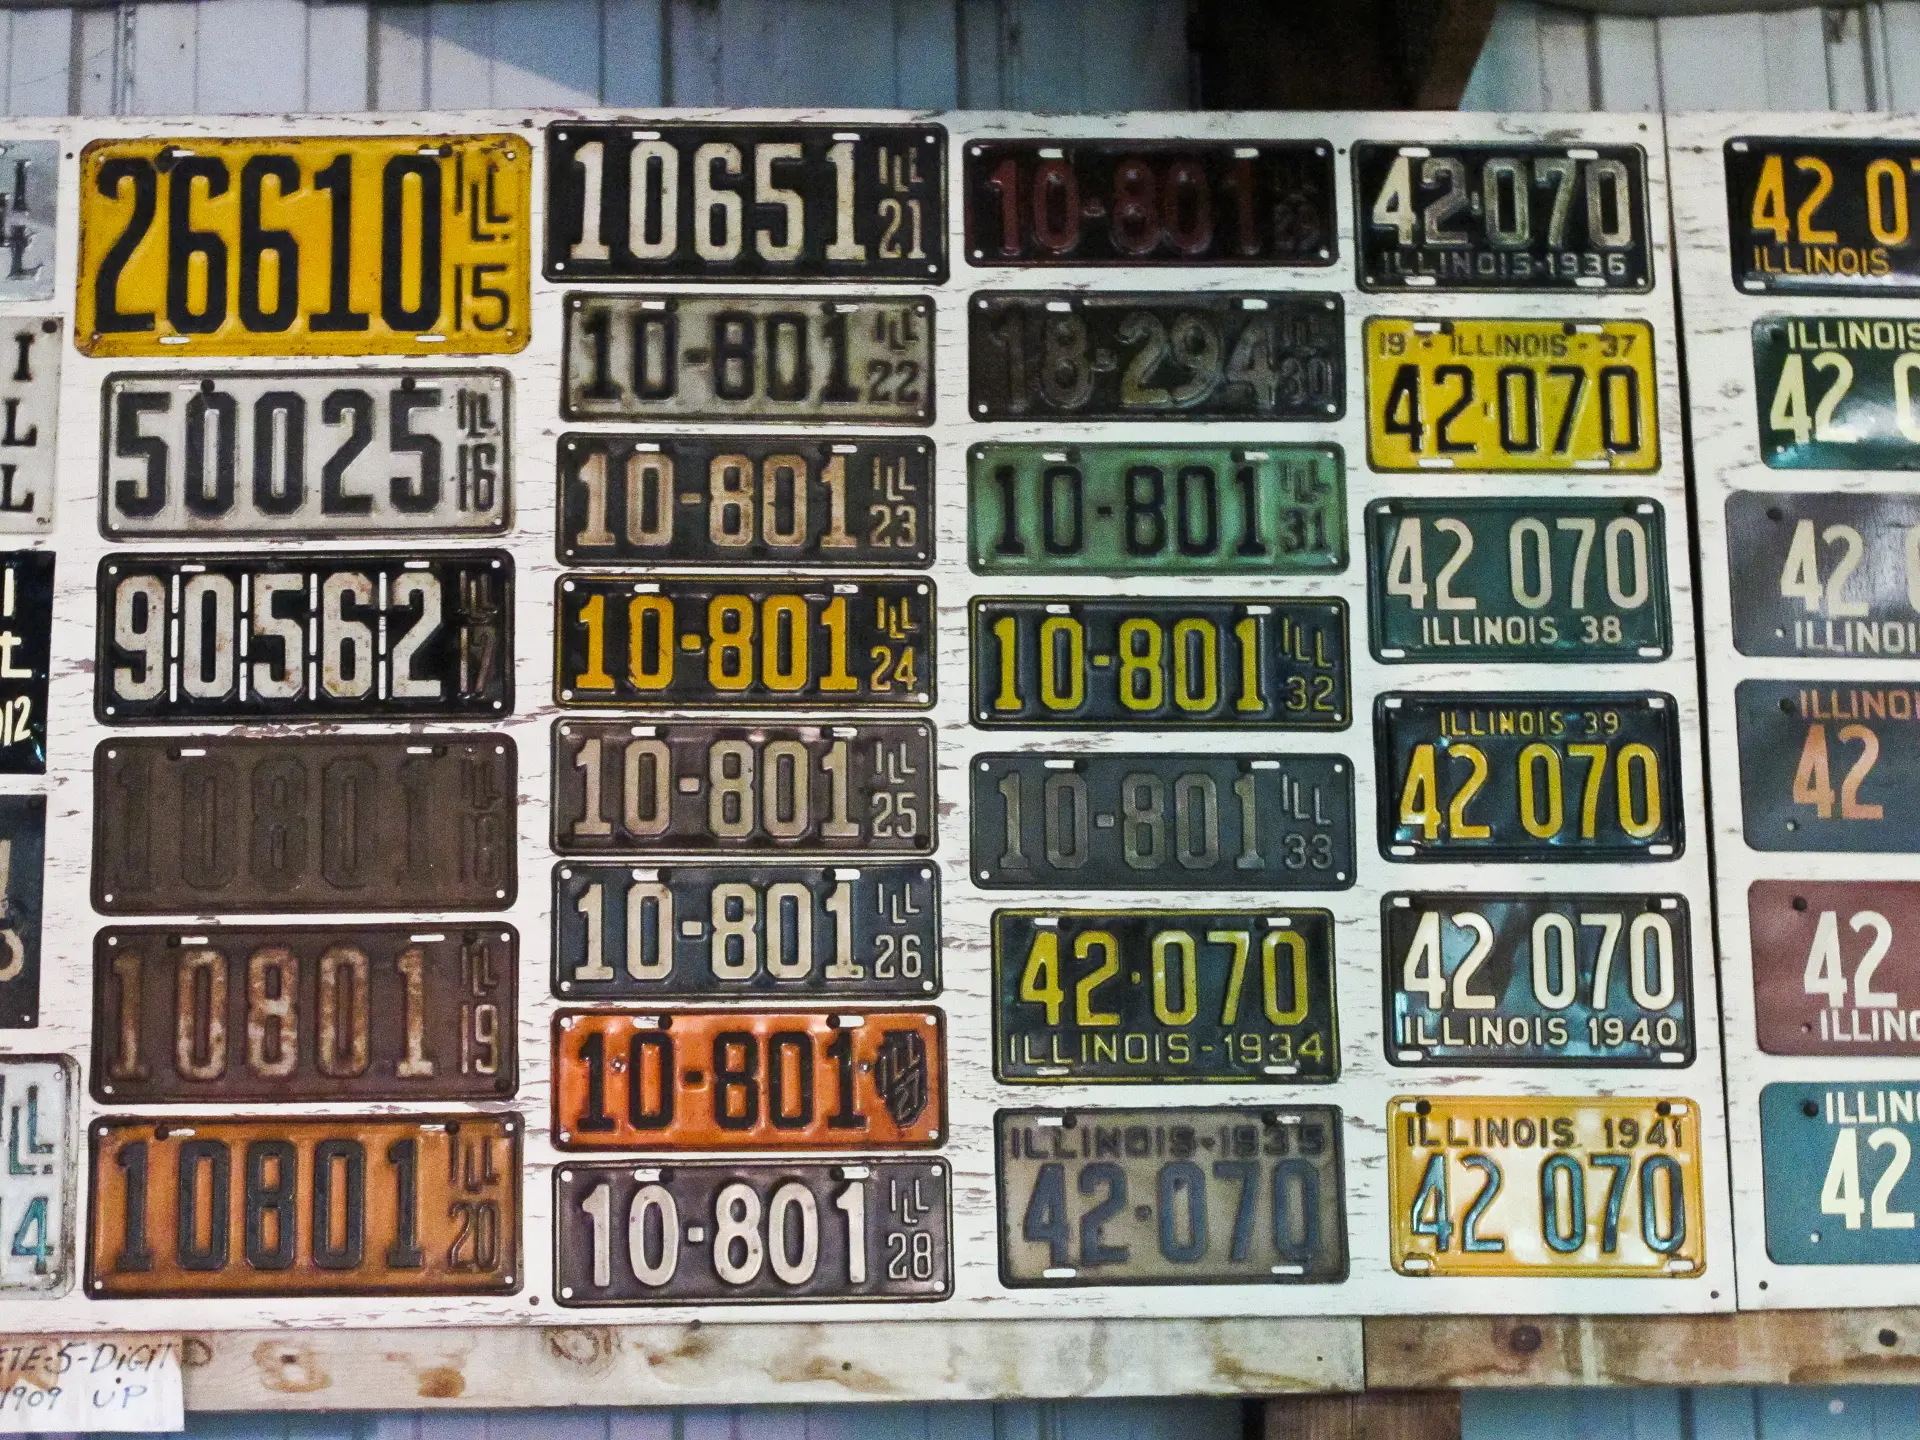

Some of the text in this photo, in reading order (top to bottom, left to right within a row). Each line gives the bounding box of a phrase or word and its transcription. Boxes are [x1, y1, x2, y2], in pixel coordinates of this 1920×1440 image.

[570, 141, 866, 261] 10651
[878, 146, 923, 191] ILL
[991, 158, 1260, 255] 10-801
[1751, 155, 1838, 244] 42
[95, 153, 442, 333] 26610
[878, 199, 927, 259] 21
[1754, 247, 1891, 276] ILLINOIS
[455, 264, 510, 331] 15
[581, 309, 860, 402] 10-801
[867, 359, 920, 400] 22
[1770, 352, 1857, 445] 42
[115, 389, 442, 516] 50025
[457, 443, 496, 511] 16
[873, 456, 916, 501] ILL
[576, 453, 857, 548] 10-801
[869, 505, 917, 548] 23
[995, 464, 1267, 557] 10-801
[1387, 517, 1649, 611] 42 070
[1781, 519, 1869, 617] 42
[113, 571, 442, 700] 90562
[575, 593, 858, 691] 10-801
[877, 597, 918, 639] ILL
[1422, 615, 1622, 646] ILLINOIS 38
[870, 646, 917, 691] 24
[993, 616, 1265, 712] 10-801
[1285, 675, 1335, 711] 32
[0, 695, 31, 746] 12
[874, 742, 916, 784] ILL
[1440, 711, 1622, 736] ILLINOIS 39
[574, 738, 860, 838] 10-801
[872, 792, 917, 838] 25
[1400, 743, 1662, 840] 42 070
[1793, 724, 1884, 820] 42
[998, 772, 1265, 871] 10-801
[1283, 833, 1333, 871] 33
[575, 882, 864, 980] 10-801
[877, 883, 920, 924] ILL
[874, 934, 922, 978] 26
[1403, 911, 1675, 1010] 42 070
[1804, 910, 1898, 1008] 42
[110, 946, 434, 1080] 10801
[462, 1004, 499, 1074] 19
[1404, 1016, 1678, 1046] ILLINOIS 1940
[576, 1031, 868, 1132] 10-801
[1407, 1117, 1683, 1148] ILLINOIS 1941
[115, 1139, 425, 1271] 10801
[890, 1179, 929, 1225] ILL
[1411, 1153, 1687, 1254] 42 070
[1821, 1128, 1914, 1230] 42
[448, 1203, 498, 1272] 20
[581, 1181, 866, 1287] 10-801
[887, 1232, 933, 1279] 28
